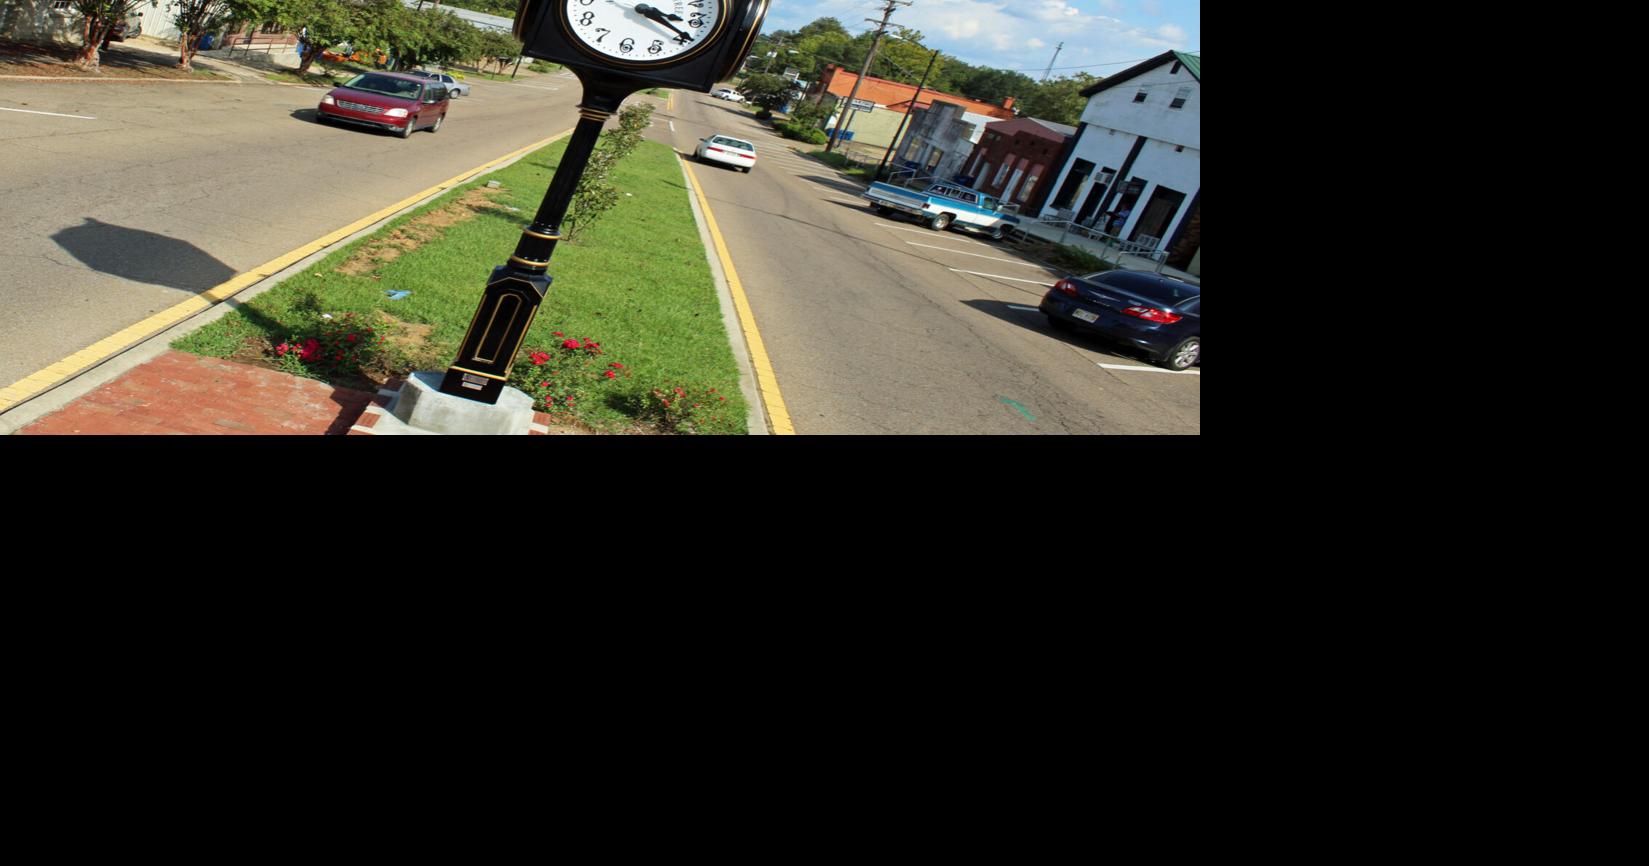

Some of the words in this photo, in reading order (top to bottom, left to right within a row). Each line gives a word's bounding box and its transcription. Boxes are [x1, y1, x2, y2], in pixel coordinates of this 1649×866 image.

[580, 11, 595, 26] 8
[688, 12, 707, 28] 3
[595, 27, 611, 43] 7
[620, 38, 635, 53] 6
[648, 39, 663, 55] 5
